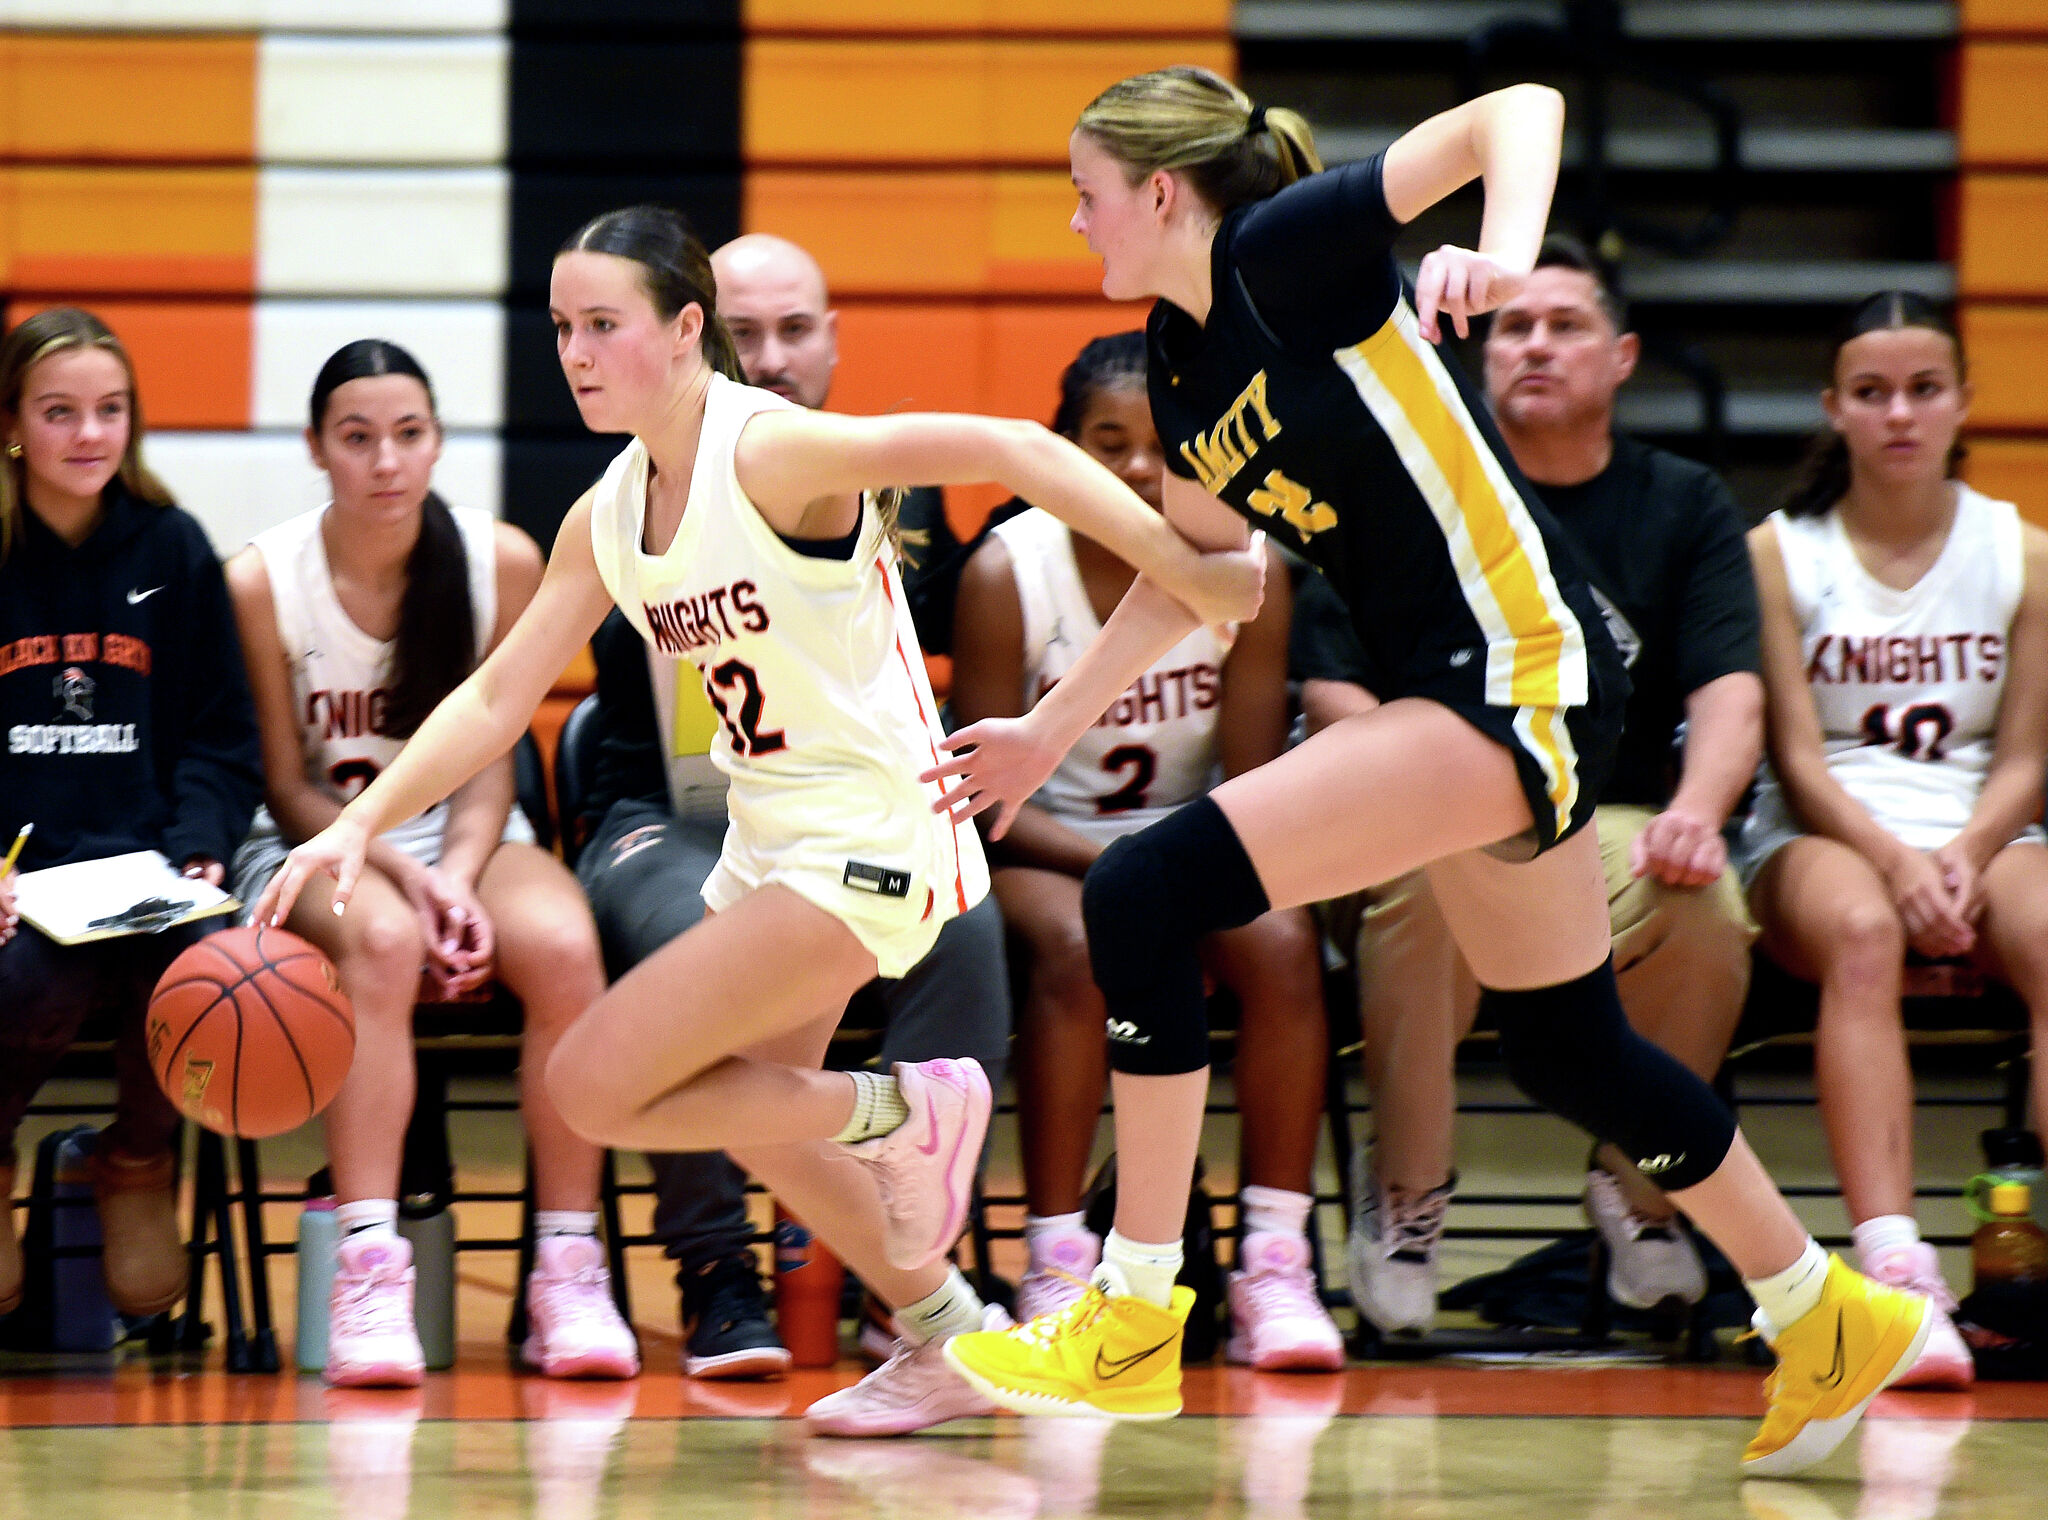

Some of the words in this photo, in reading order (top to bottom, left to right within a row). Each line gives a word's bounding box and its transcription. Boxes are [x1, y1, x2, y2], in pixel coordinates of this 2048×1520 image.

[1806, 632, 2005, 685] KNIGHTS
[1037, 663, 1221, 727] GHTS
[8, 723, 140, 755] SOFTBALL
[1095, 743, 1158, 815] 2
[888, 876, 902, 893] M
